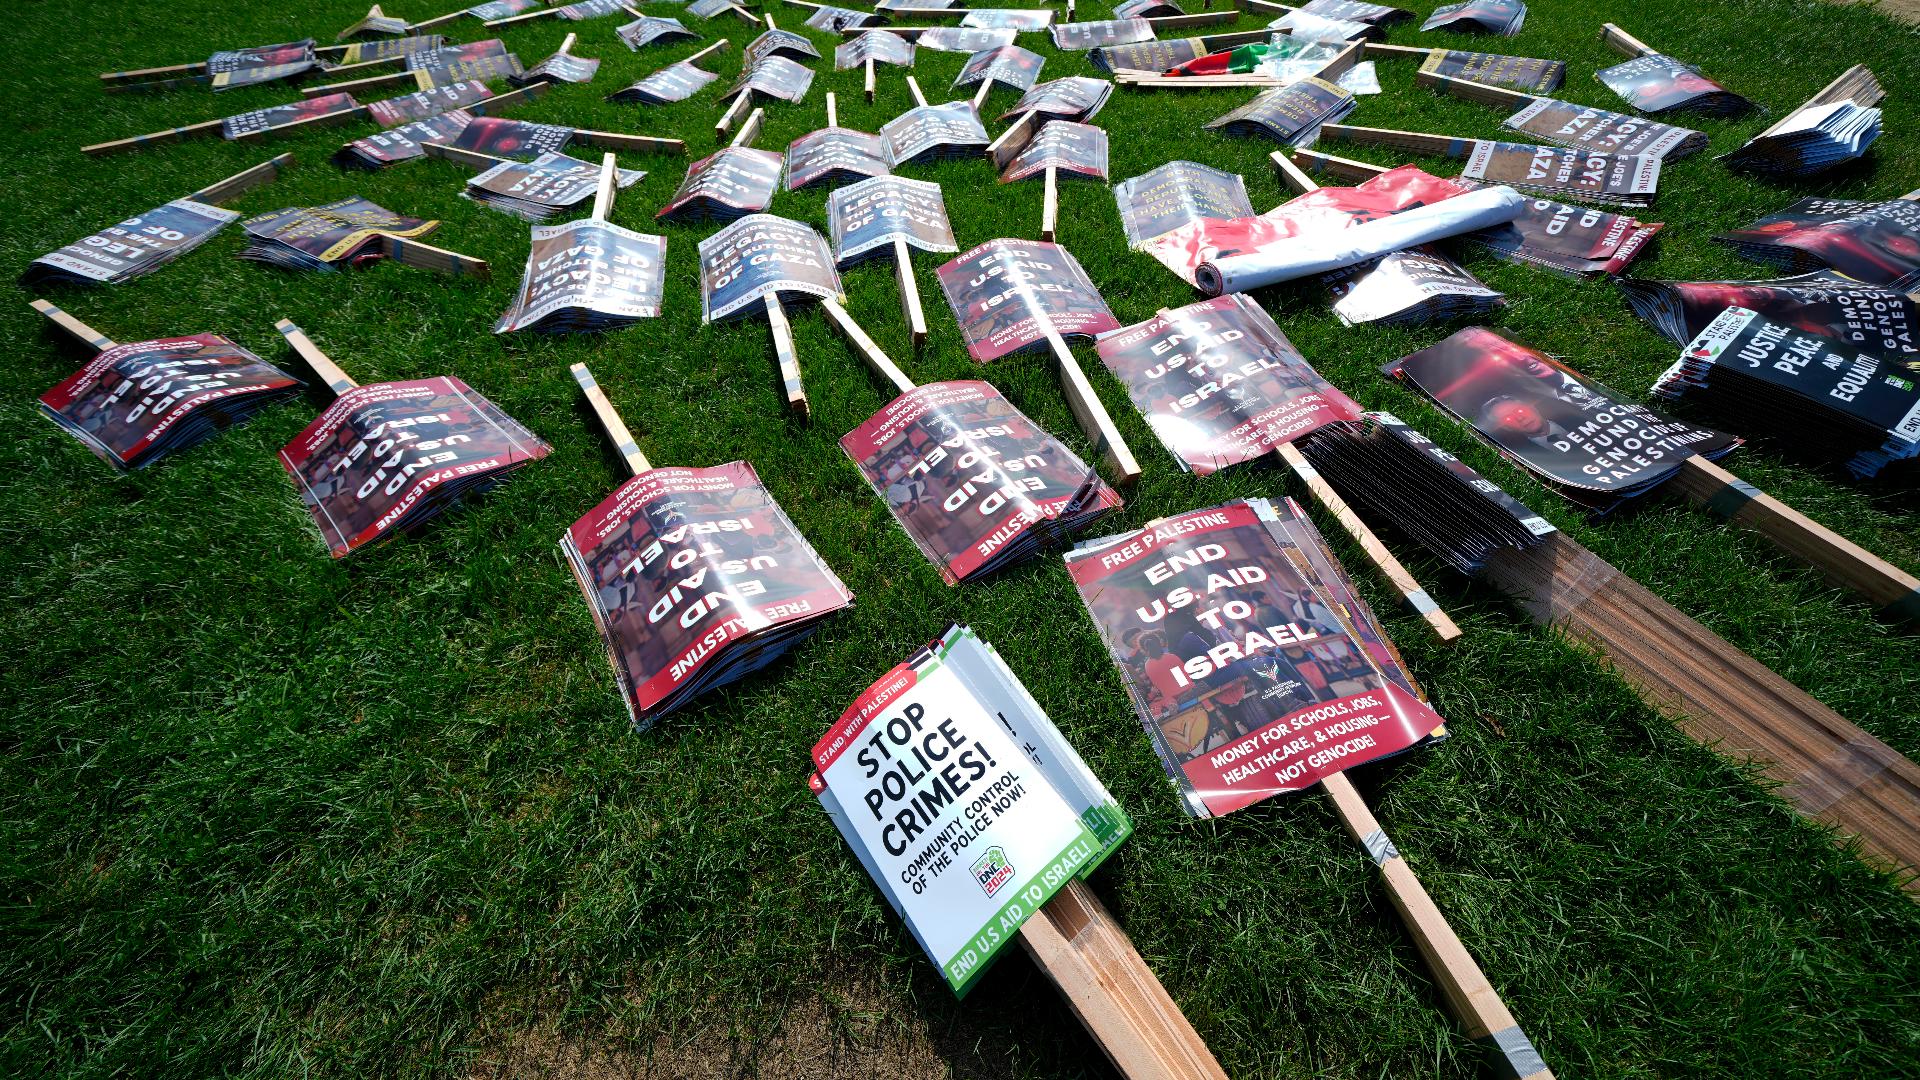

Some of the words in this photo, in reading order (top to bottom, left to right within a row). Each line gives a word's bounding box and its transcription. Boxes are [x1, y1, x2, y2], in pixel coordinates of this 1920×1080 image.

[1557, 108, 1598, 135] AZA
[1526, 147, 1556, 180] AZA
[142, 226, 185, 240] OF
[847, 214, 874, 232] OF
[882, 209, 945, 230] GAZA
[1546, 205, 1575, 235] AID
[126, 234, 163, 248] THE
[538, 245, 604, 270] GAZA
[711, 232, 812, 268] LEGACY:
[957, 248, 981, 264] FREE
[712, 257, 739, 276] THE
[715, 265, 744, 288] OF
[750, 253, 822, 268] GAZA
[979, 250, 1030, 268] END
[1849, 291, 1877, 331] FUND
[990, 325, 1018, 342] MONEY
[1021, 331, 1038, 341] NOT
[1118, 328, 1150, 347] FREE
[1144, 354, 1191, 380] U.S.
[1196, 329, 1244, 352] AID
[1188, 354, 1229, 378] TO
[1822, 353, 1844, 371] AND
[125, 380, 174, 424] AID
[151, 380, 229, 415] END
[1169, 358, 1282, 413] ISRAEL
[880, 403, 916, 431] HOUSING
[1230, 422, 1252, 436] FOR
[1252, 402, 1299, 425] SCHOOLS,
[1263, 418, 1314, 443] GENOCIDE!
[332, 413, 451, 473] ISRAEL
[373, 431, 419, 457] TO
[874, 427, 896, 446] JOBS,
[908, 426, 1015, 475] ISRAEL
[1582, 419, 1639, 455] FUND
[356, 449, 405, 499] AID
[385, 451, 459, 497] END
[456, 459, 500, 475] FREE
[957, 450, 1000, 468] TO
[617, 471, 669, 501] GENOCIDE!
[658, 477, 728, 485] HEALTHCARE,
[943, 471, 997, 512] AID
[978, 477, 1047, 515] END
[376, 470, 455, 531] PALESTINE
[622, 487, 670, 516] SCHOOLS,
[597, 516, 621, 538] JOBS,
[1101, 536, 1142, 570] FREE
[1142, 513, 1229, 550] PALESTINE
[622, 519, 755, 575] ISRAEL
[670, 543, 723, 570] TO
[1144, 543, 1227, 586] END
[649, 569, 708, 624] AID
[680, 580, 767, 629] END
[767, 600, 811, 619] FREE
[1136, 587, 1200, 624] U.S.
[1206, 566, 1268, 594] AID
[1196, 600, 1252, 630] TO
[1169, 623, 1317, 688] ISRAEL
[819, 735, 844, 764] STAND
[843, 716, 863, 738] WITH
[861, 678, 908, 718] PALESTINE!
[1210, 737, 1261, 769] MONEY
[1260, 721, 1290, 744] FOR
[1290, 702, 1353, 730] SCHOOLS,
[1353, 696, 1382, 713] JOBS,
[857, 702, 925, 778] STOP
[1222, 736, 1316, 785] HEALTHCARE,
[1315, 729, 1327, 742] &
[865, 718, 967, 821] POLICE
[1274, 759, 1307, 784] NOT
[1307, 734, 1376, 769] GENOCIDE!
[882, 742, 996, 856] CRIMES!
[901, 818, 963, 883] COMMUNITY
[964, 771, 1019, 821] CONTROL
[913, 875, 930, 894] OF
[930, 851, 953, 878] THE
[951, 813, 992, 856] POLICE
[994, 787, 1026, 818] NOW!
[979, 862, 1000, 884] DNC
[985, 865, 1012, 893] 2024
[951, 949, 977, 980] END
[977, 928, 1000, 954] U.S
[1001, 904, 1023, 931] AID
[1023, 885, 1042, 912] TO
[1042, 842, 1091, 891] ISRAEL!
